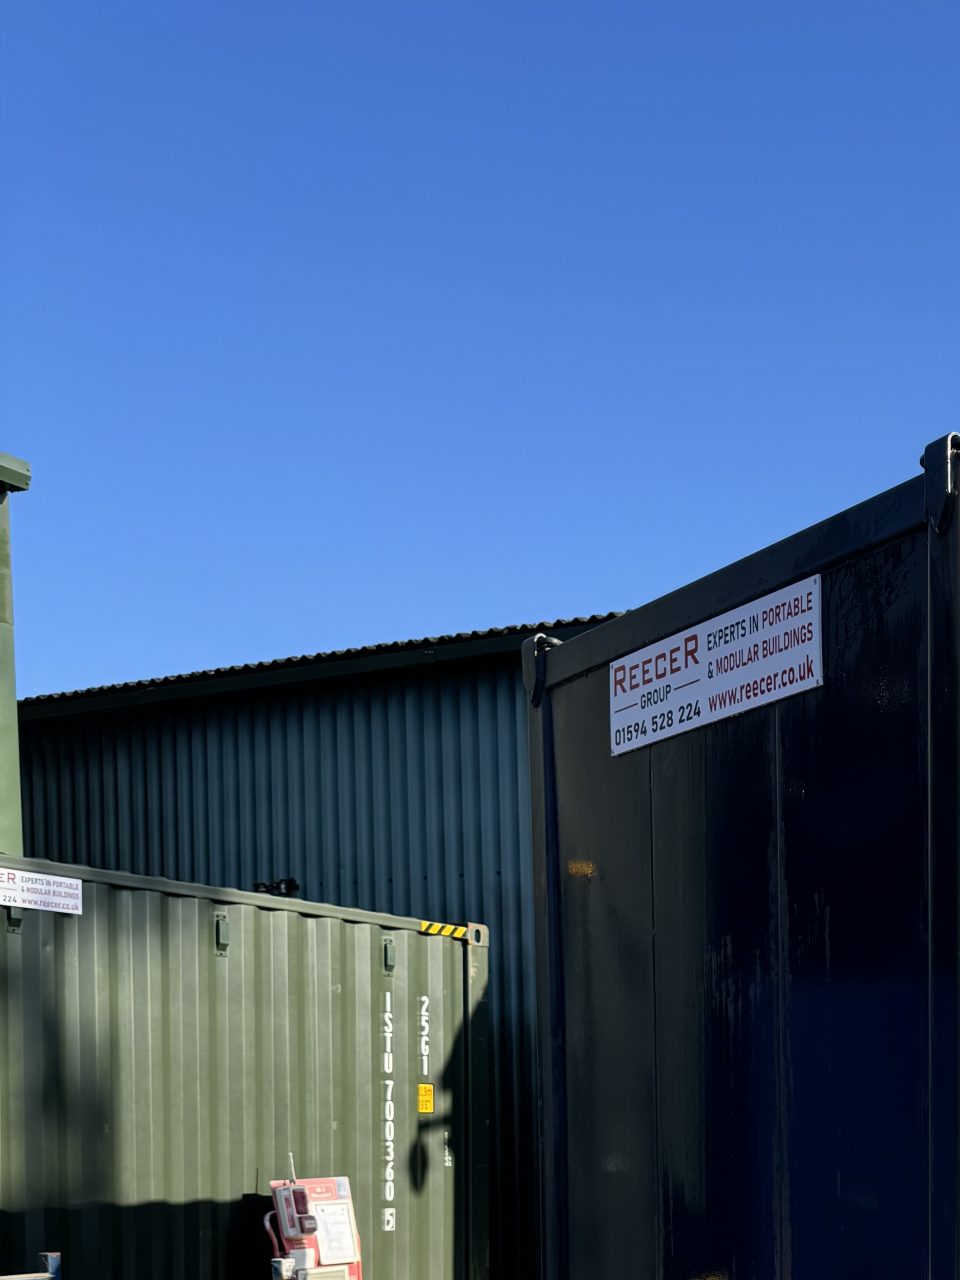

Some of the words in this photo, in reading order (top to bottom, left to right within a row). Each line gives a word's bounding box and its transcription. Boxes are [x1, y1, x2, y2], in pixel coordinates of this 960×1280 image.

[706, 619, 747, 652] EXPERTS
[749, 613, 759, 635] IN
[762, 591, 813, 630] PORTABLE
[613, 633, 700, 697] REECER
[707, 661, 714, 679] &
[715, 643, 759, 676] MODULAR
[762, 622, 813, 659] BUILDINGS
[640, 684, 672, 710] GROUP
[708, 654, 815, 713] www.reecer.co.uk
[615, 719, 648, 746] 01594
[651, 709, 674, 734] 528
[678, 699, 702, 724] 224
[2, 894, 18, 903] 224
